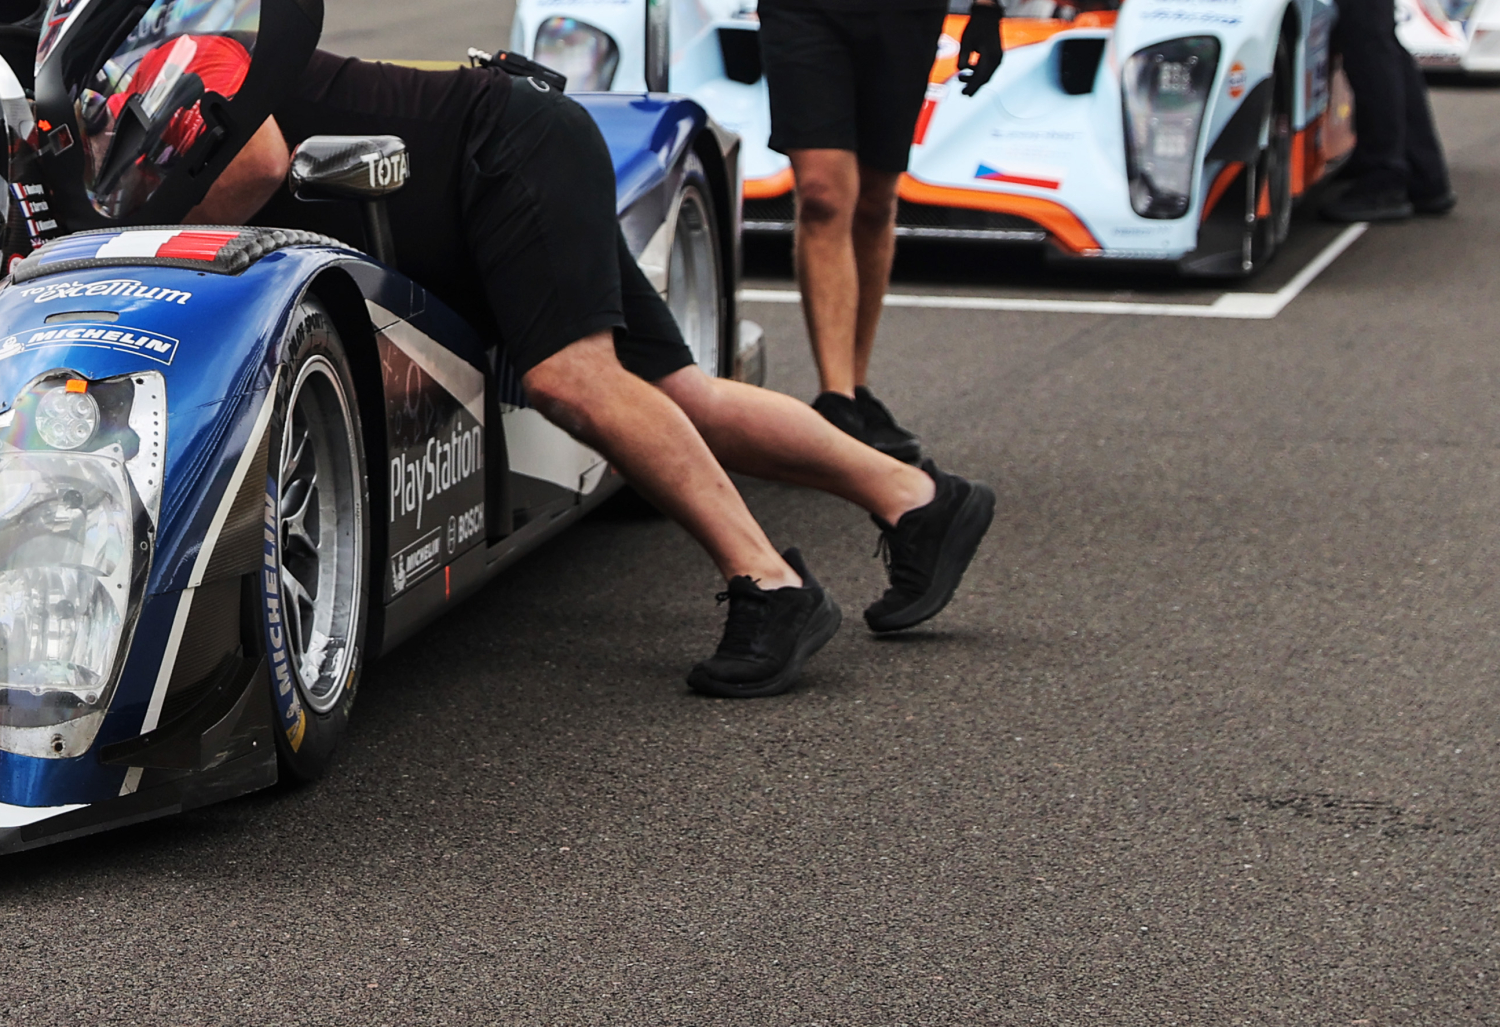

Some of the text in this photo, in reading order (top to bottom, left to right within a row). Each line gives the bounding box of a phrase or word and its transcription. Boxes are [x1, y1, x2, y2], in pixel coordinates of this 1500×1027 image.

[20, 280, 83, 299] TOTAL
[34, 279, 193, 305] excellium
[28, 327, 173, 354] MICHELIN
[390, 421, 483, 530] PlayStation
[405, 536, 441, 573] MICHELIN
[264, 498, 292, 697] MICHELIN
